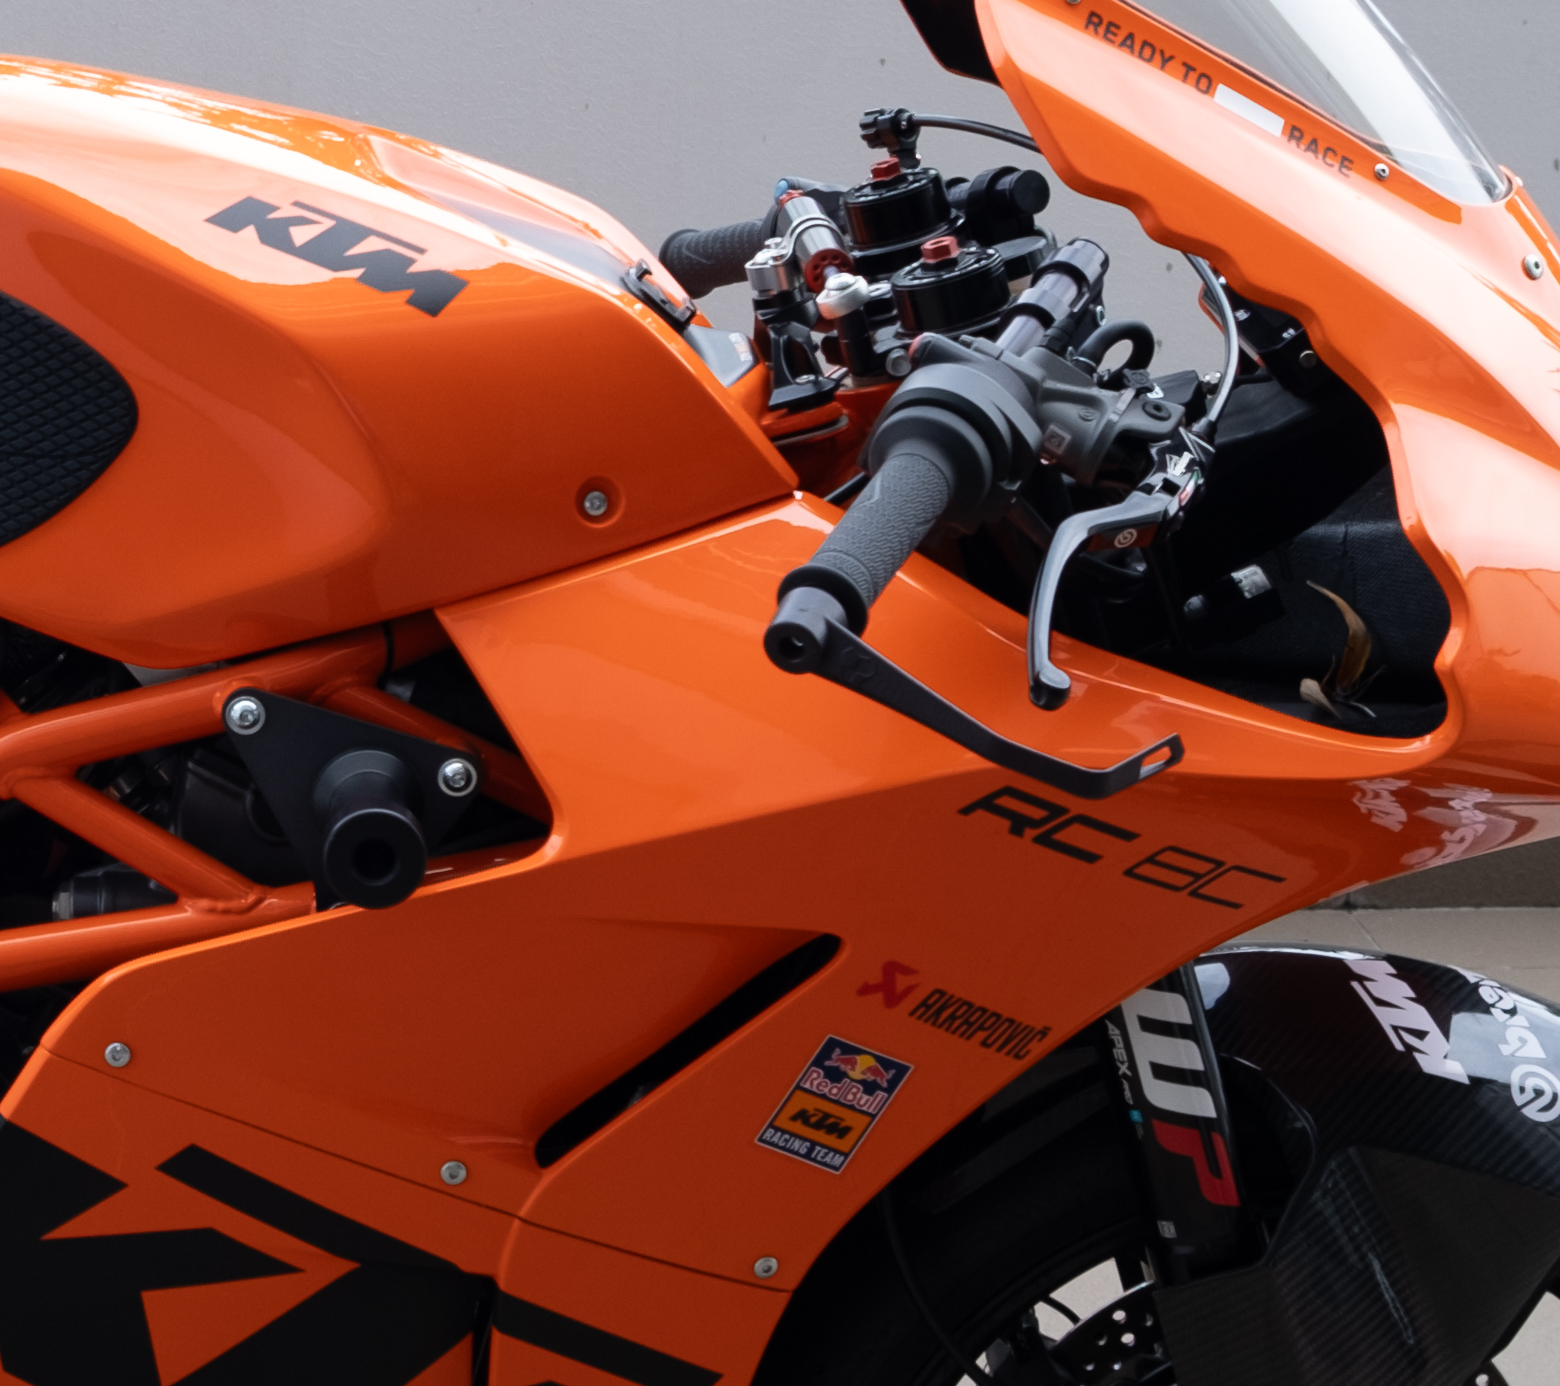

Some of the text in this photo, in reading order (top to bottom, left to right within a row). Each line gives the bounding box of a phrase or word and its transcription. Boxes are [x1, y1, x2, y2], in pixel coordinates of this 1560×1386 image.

[1083, 10, 1356, 178] READY TO RACE
[203, 195, 470, 318] KTM
[958, 785, 1287, 911] RC 8C
[1104, 1018, 1132, 1078] APEX
[1343, 959, 1470, 1085] KTM
[762, 1127, 846, 1168] RACING TEAM
[788, 1107, 854, 1140] KTM
[799, 1066, 888, 1115] Red Bull
[1120, 988, 1241, 1208] WP
